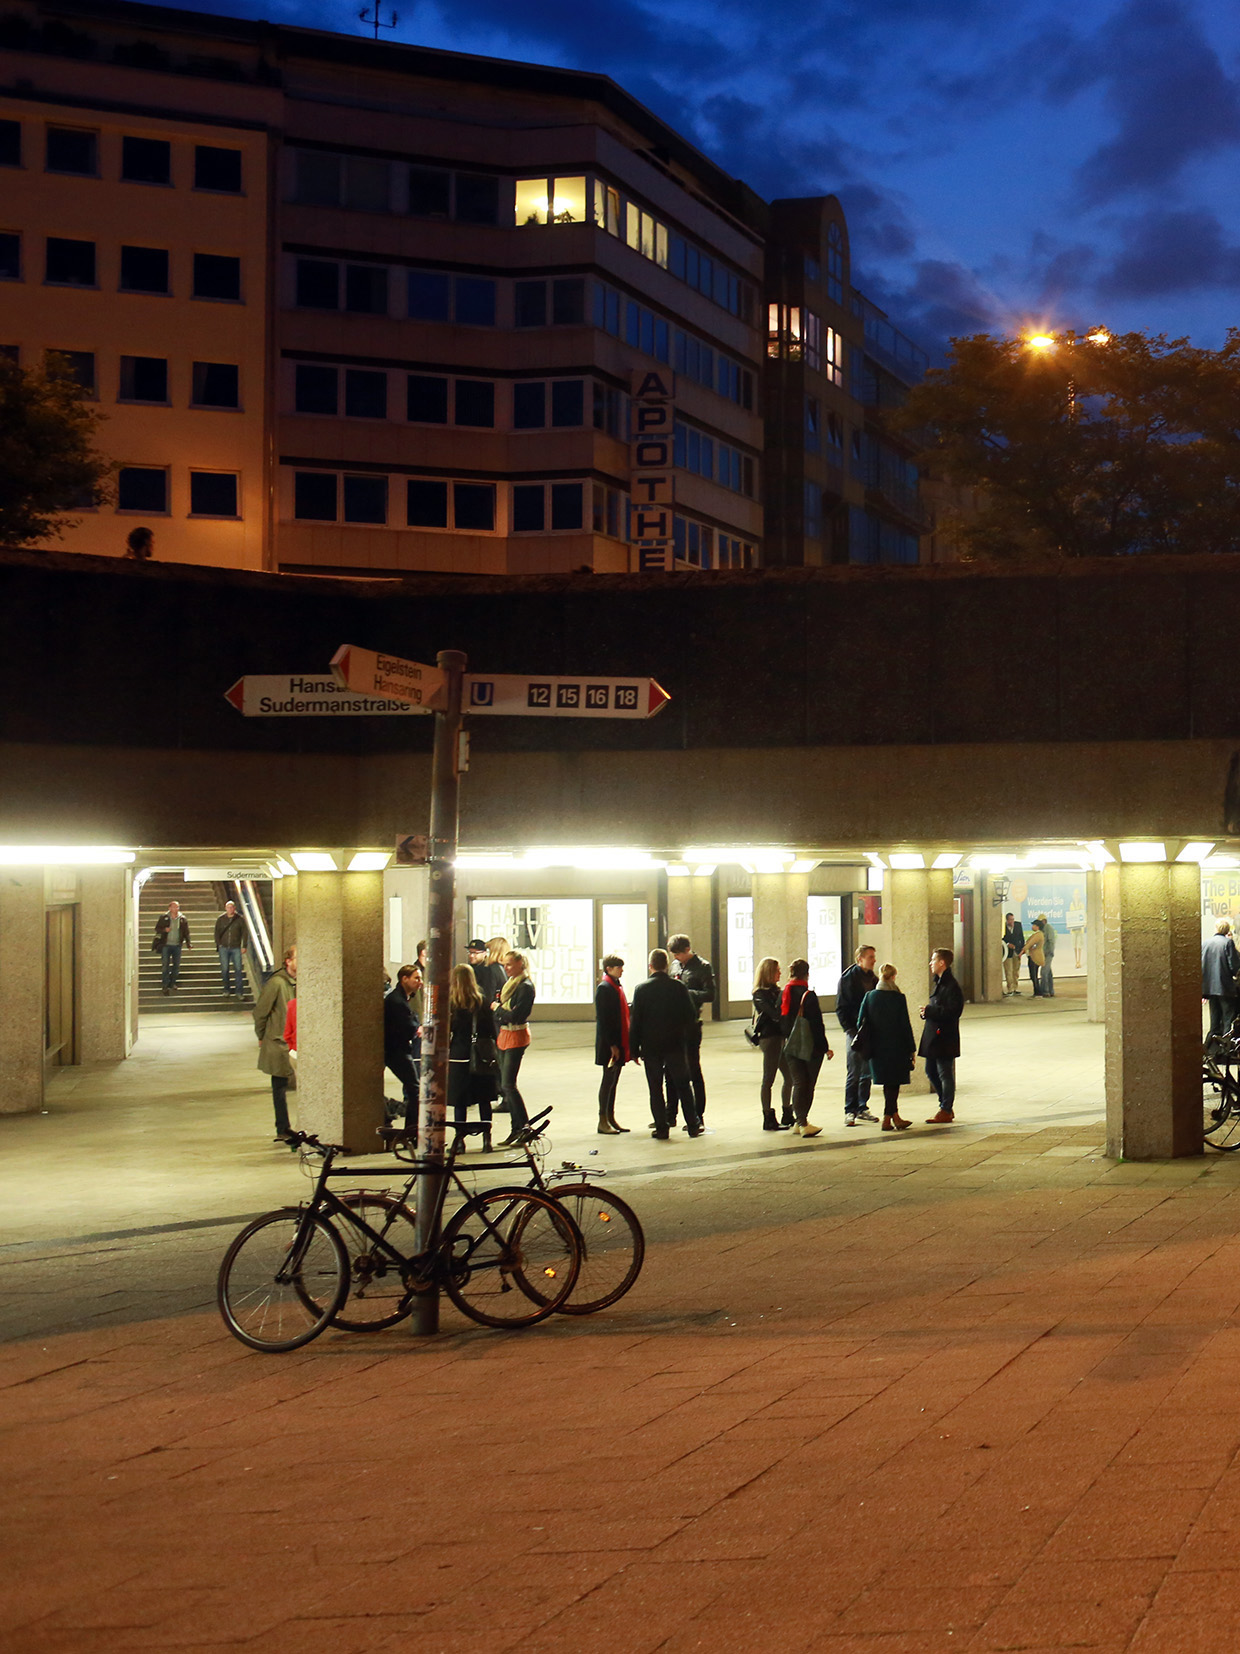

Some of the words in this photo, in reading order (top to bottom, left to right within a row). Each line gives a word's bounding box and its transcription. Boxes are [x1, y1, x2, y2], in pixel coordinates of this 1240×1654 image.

[636, 372, 668, 571] APOTHE
[376, 654, 422, 681] Eigelstein
[374, 674, 422, 704] Hansaring
[473, 684, 491, 704] U
[530, 687, 549, 704] 12
[559, 688, 578, 705] 15
[588, 689, 606, 705] 16
[616, 690, 636, 706] 18
[226, 871, 268, 879] Sudermans
[1202, 880, 1225, 897] The
[1027, 896, 1052, 906] Werden
[1203, 899, 1231, 915] Five!
[490, 903, 552, 924] HALLE
